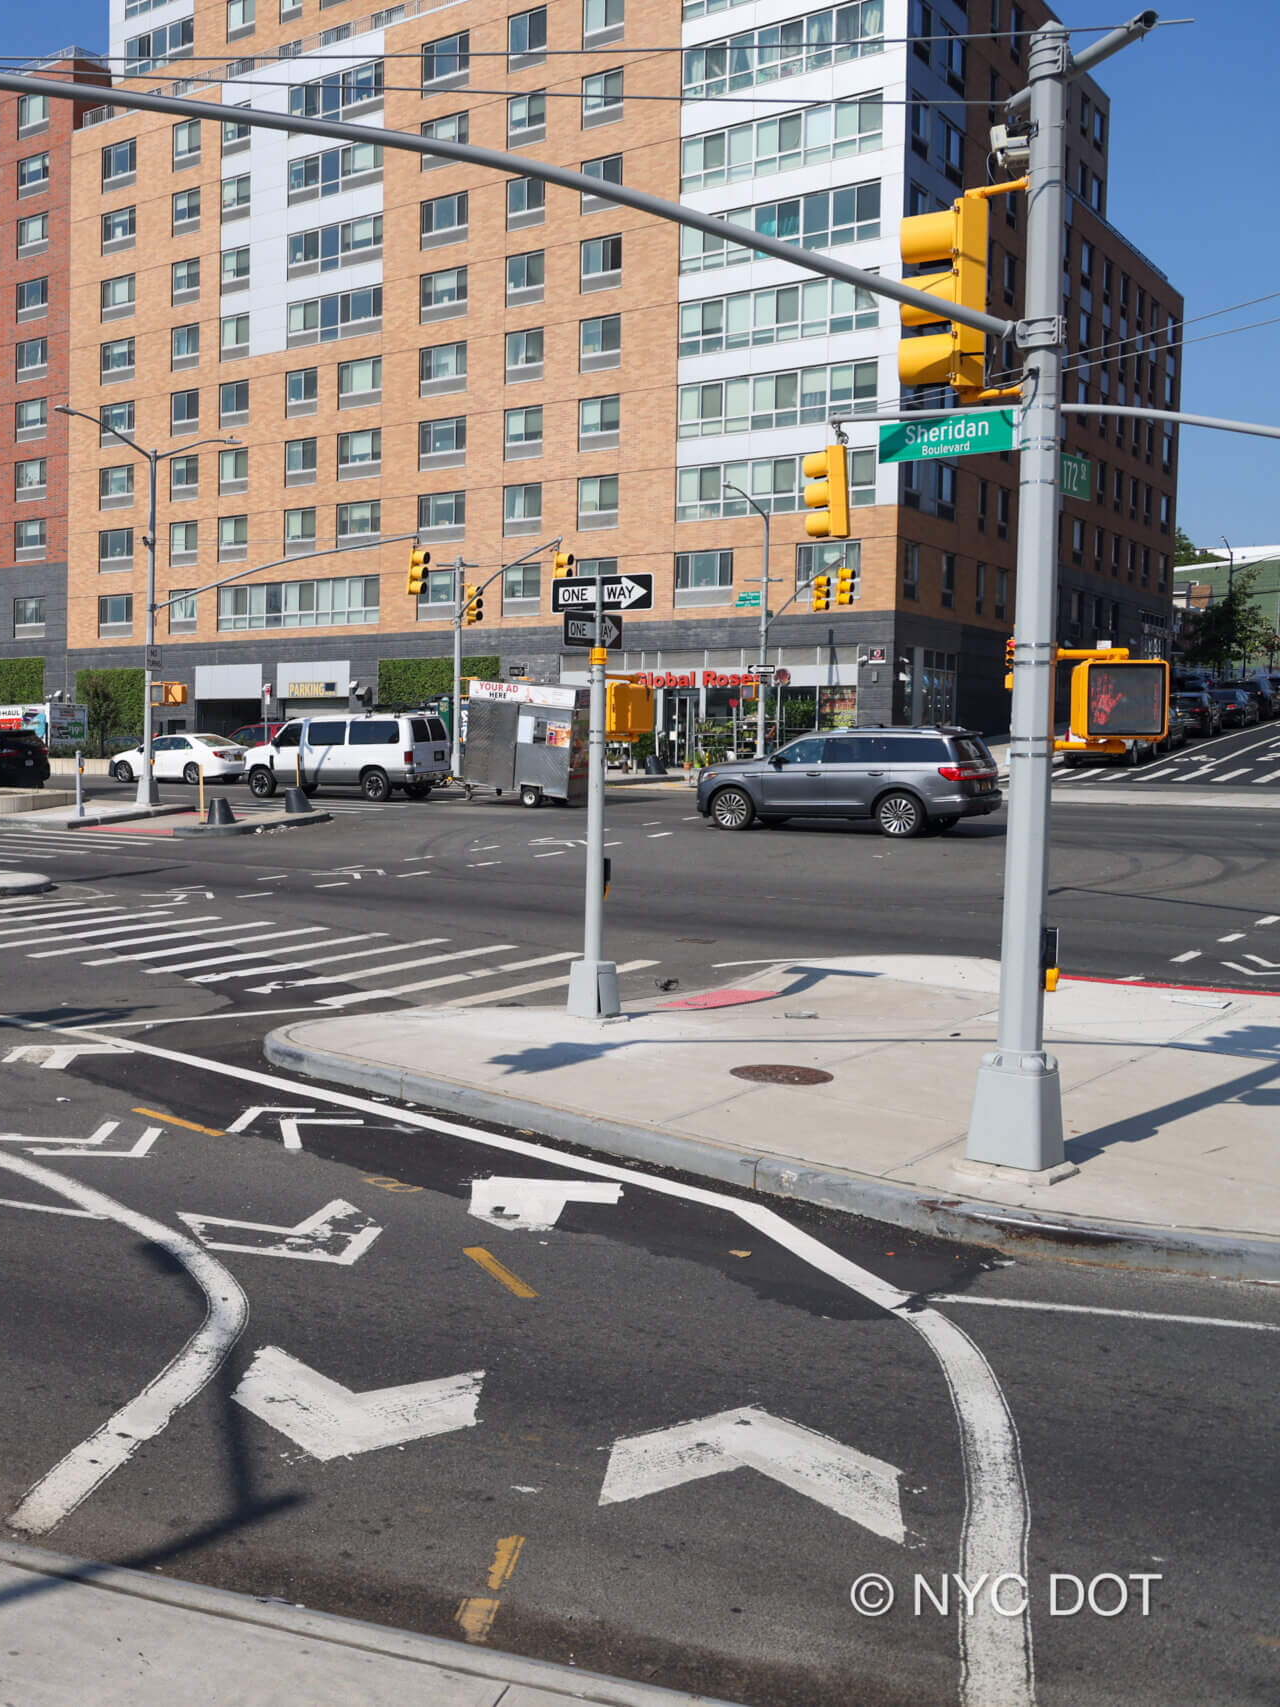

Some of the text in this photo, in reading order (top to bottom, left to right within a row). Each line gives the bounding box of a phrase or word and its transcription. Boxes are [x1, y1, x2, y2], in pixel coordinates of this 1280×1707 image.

[904, 419, 990, 445] Sheridan
[921, 440, 971, 456] Boulevard
[1063, 460, 1079, 492] 172
[562, 585, 635, 603] ONE WAY
[570, 622, 587, 637] ONE
[479, 681, 519, 693] YOUR AD
[635, 671, 696, 689] Global
[288, 682, 325, 697] PARKING
[489, 691, 507, 699] HERE
